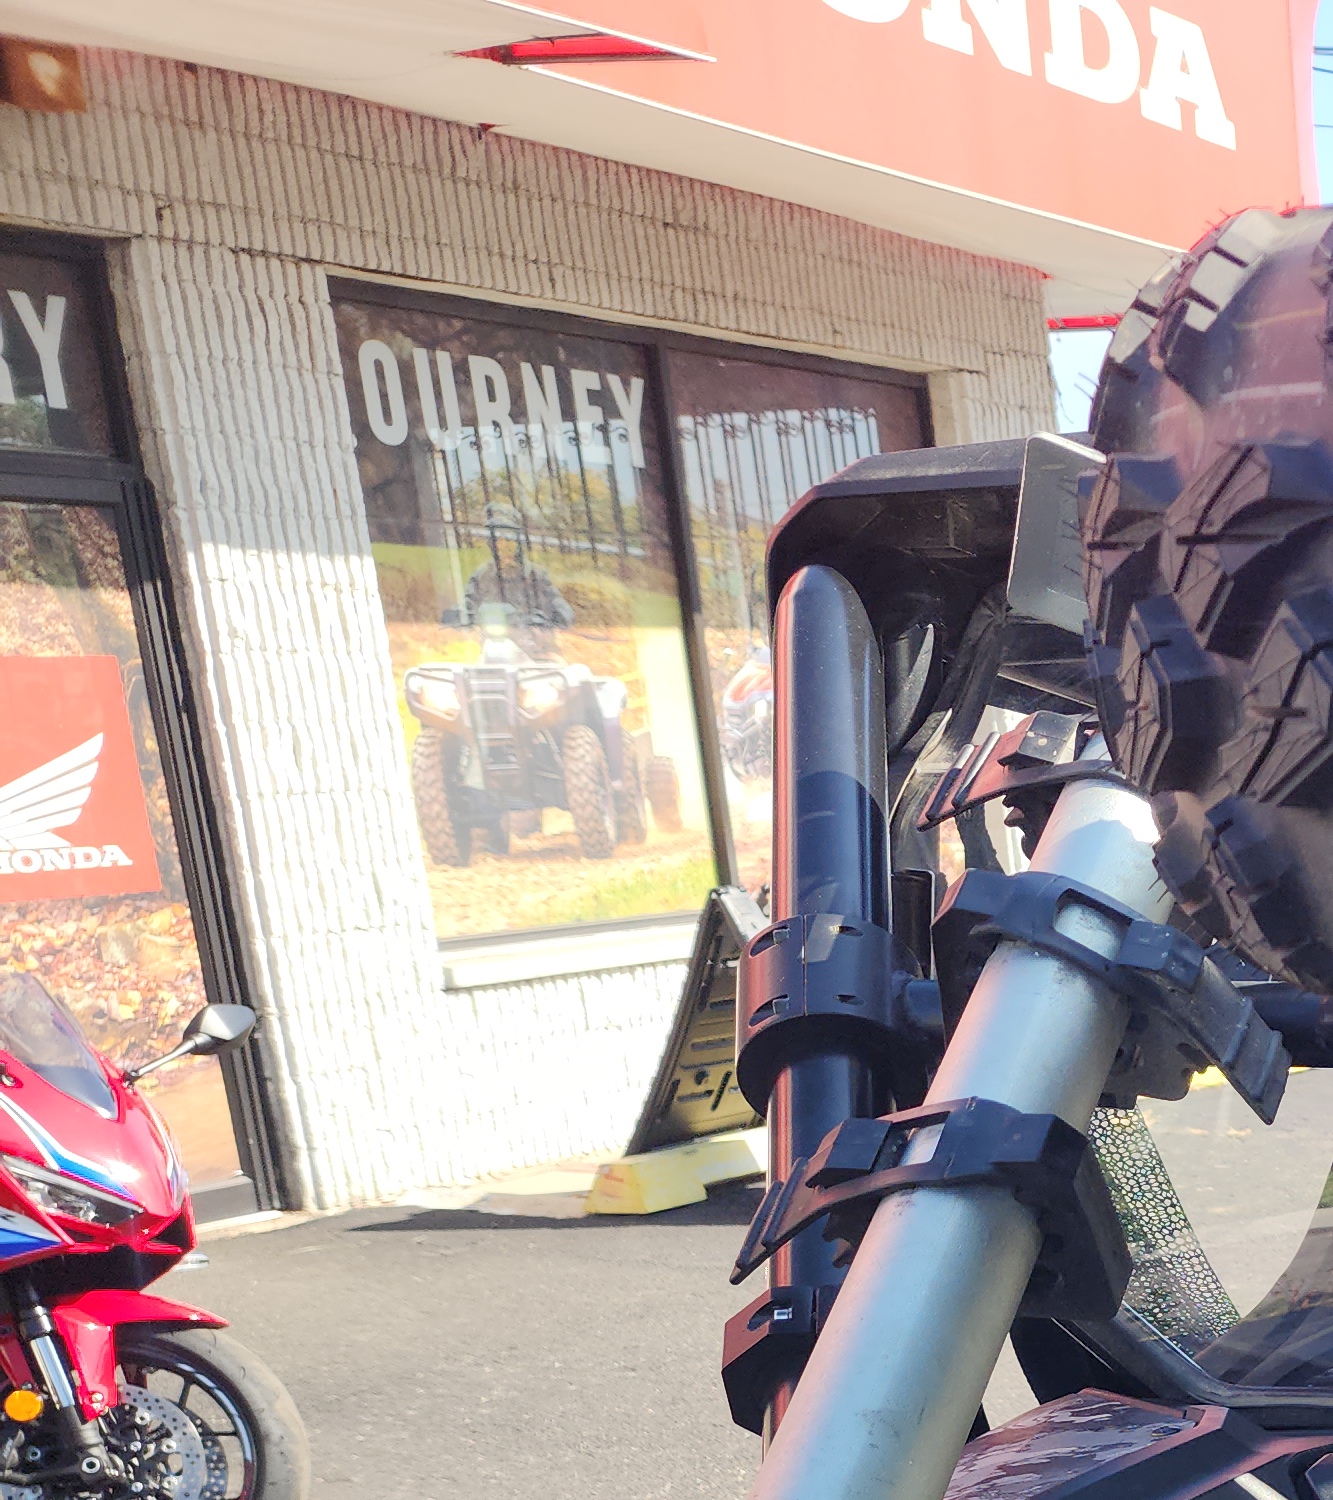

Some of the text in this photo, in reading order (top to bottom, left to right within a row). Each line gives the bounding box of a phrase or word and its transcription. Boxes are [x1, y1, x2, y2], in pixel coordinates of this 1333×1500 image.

[820, 0, 1237, 151] NDA
[0, 289, 68, 409] Y
[358, 339, 646, 468] OURNEY
